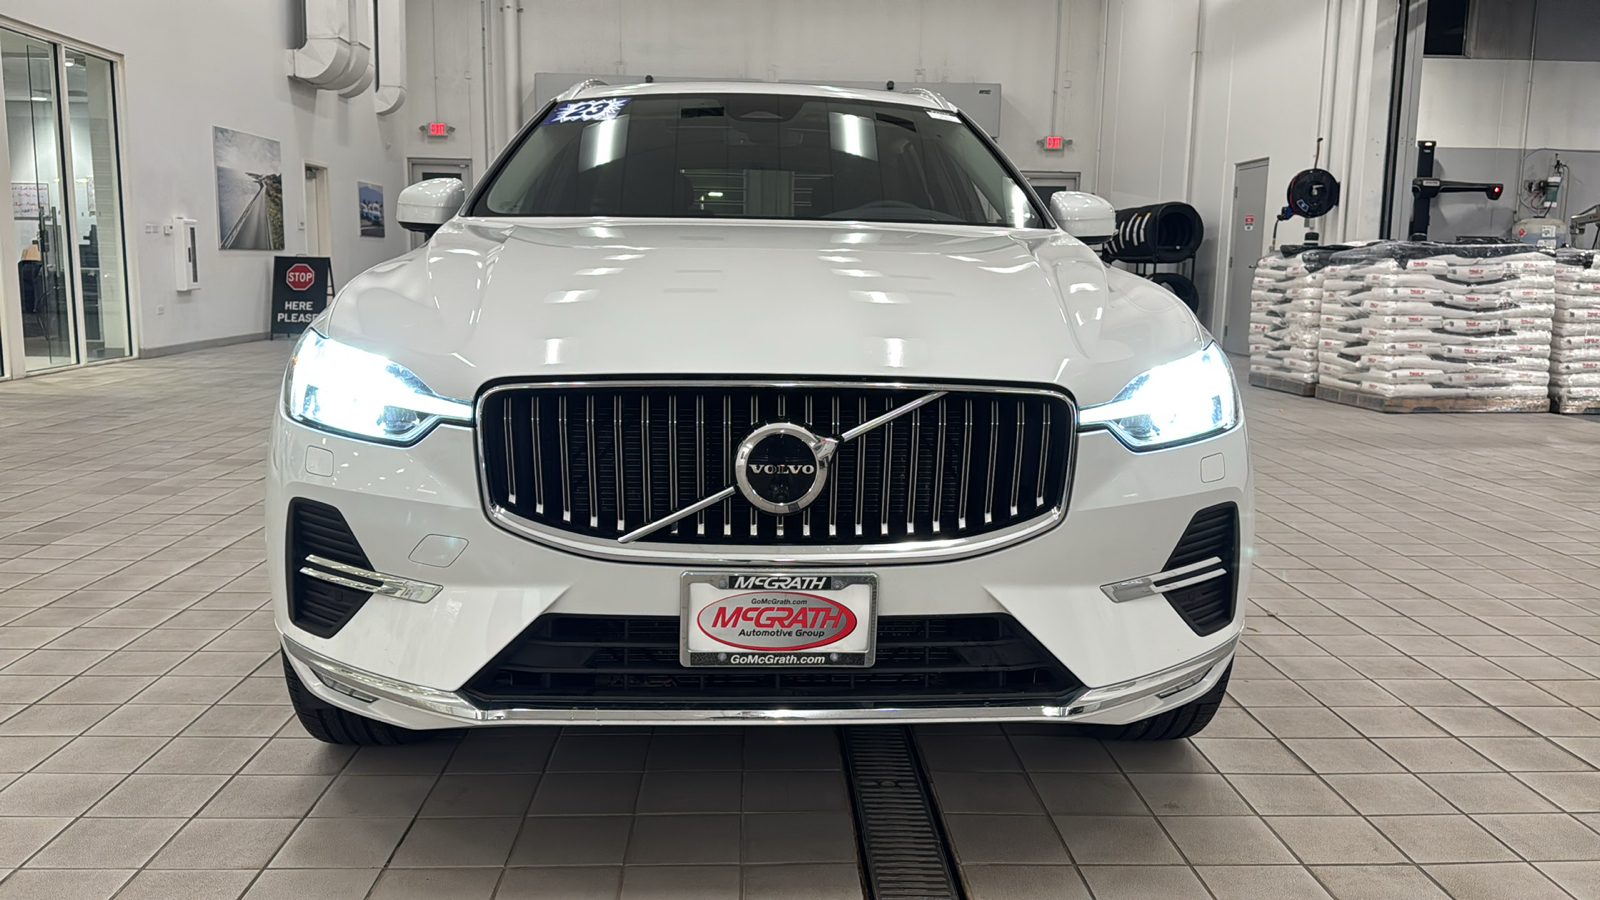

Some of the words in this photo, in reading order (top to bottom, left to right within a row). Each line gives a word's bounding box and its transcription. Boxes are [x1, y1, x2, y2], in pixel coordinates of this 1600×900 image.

[565, 102, 610, 117] 23
[288, 272, 313, 282] STOP
[284, 301, 313, 311] HERE
[748, 464, 815, 474] VOLVO
[738, 628, 793, 637] Automotive
[795, 629, 825, 638] Group
[730, 655, 825, 664] GoMcGrath.com
